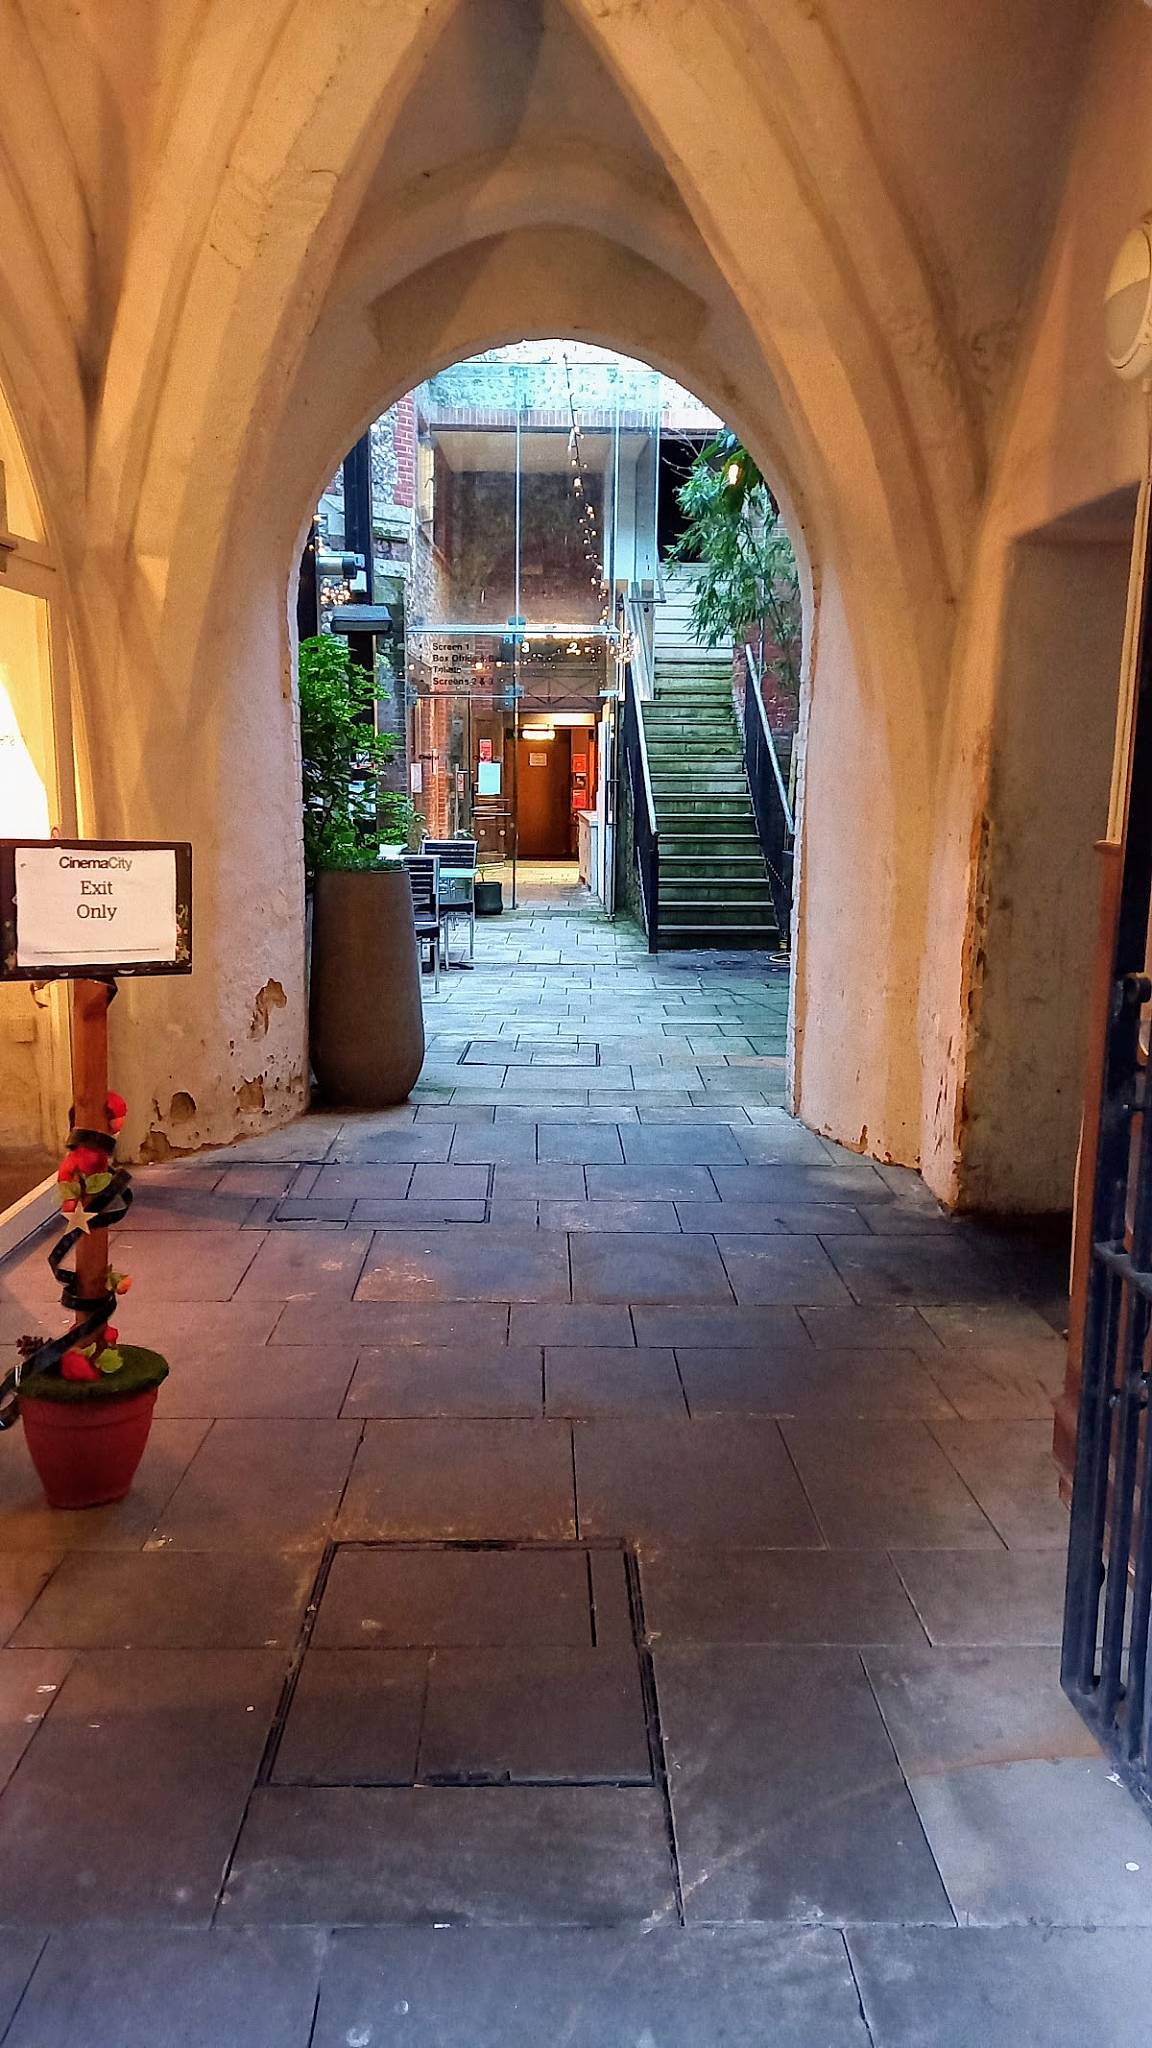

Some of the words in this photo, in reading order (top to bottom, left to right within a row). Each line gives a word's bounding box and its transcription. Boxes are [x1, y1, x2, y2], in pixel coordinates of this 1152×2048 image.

[433, 643, 462, 651] Screen
[465, 643, 470, 651] 1
[433, 654, 448, 662] Box
[433, 677, 469, 685] Screens
[59, 856, 132, 871] CinemaCity
[80, 880, 113, 895] Exit
[76, 904, 117, 921] Only
